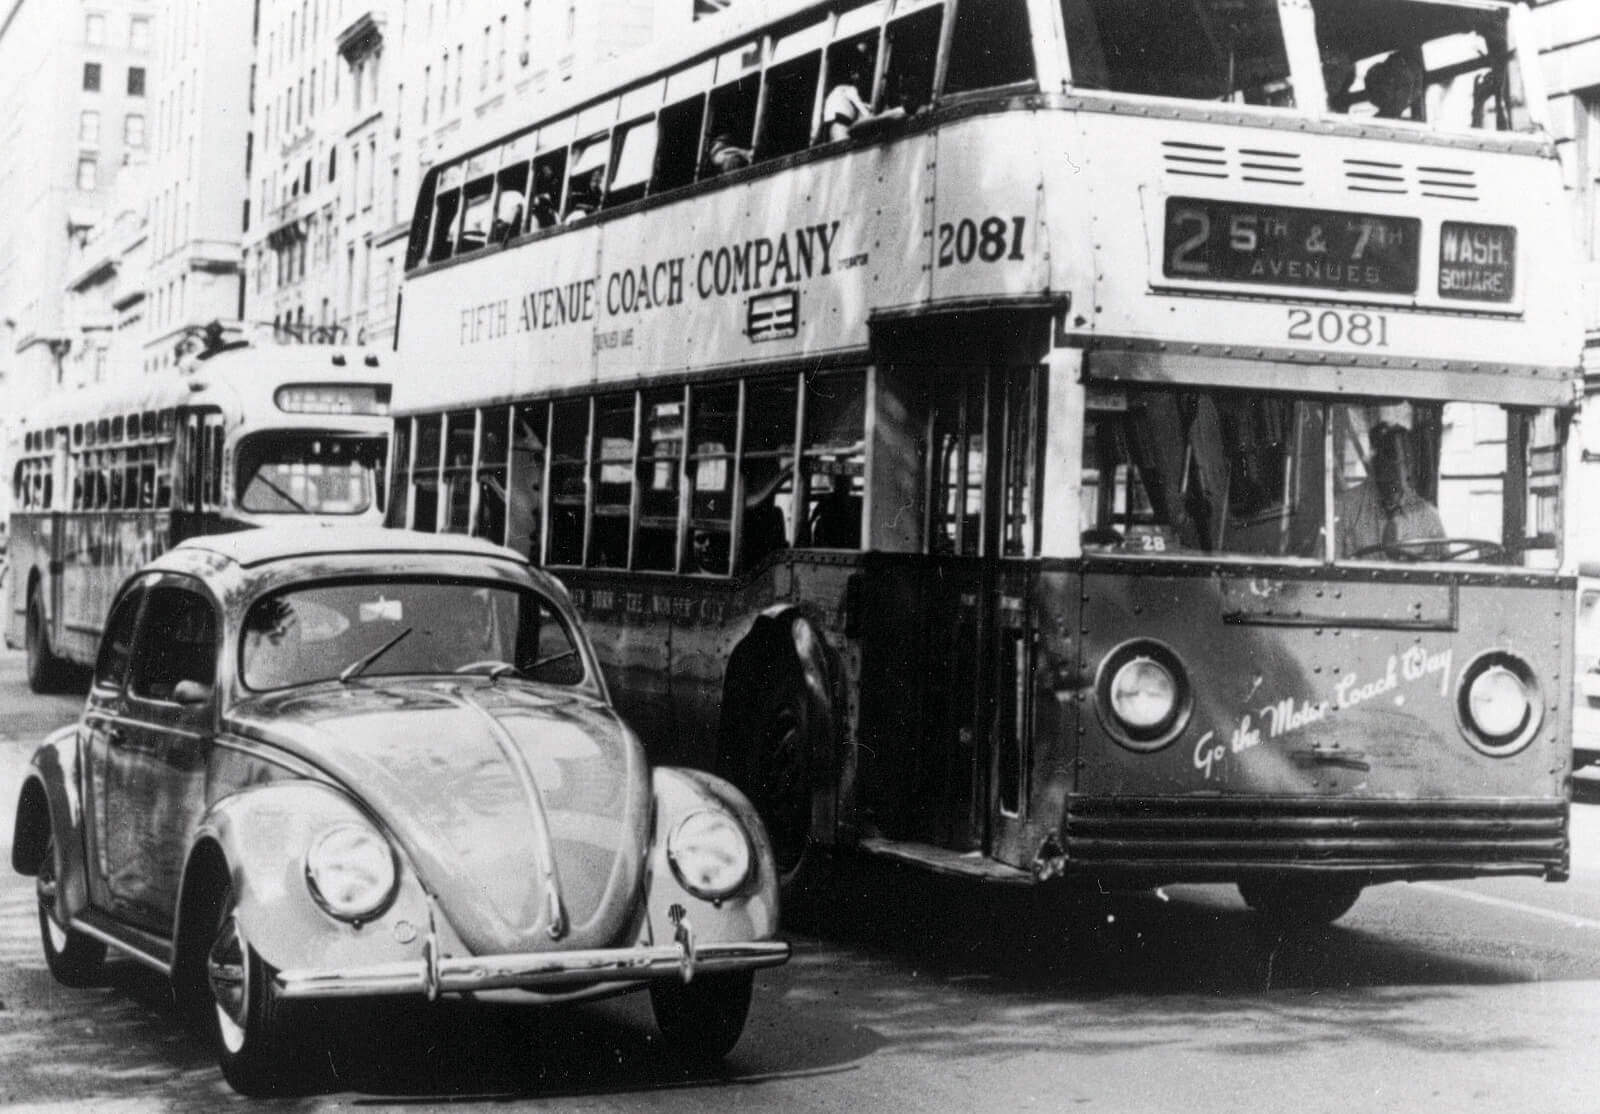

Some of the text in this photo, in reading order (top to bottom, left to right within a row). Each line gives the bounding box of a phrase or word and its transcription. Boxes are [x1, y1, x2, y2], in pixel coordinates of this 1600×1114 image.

[938, 216, 1025, 268] 2081
[1170, 208, 1211, 273] 2
[1305, 226, 1327, 254] &
[460, 221, 839, 345] FIFTH AVENUE COACH COMPANY
[1250, 259, 1380, 284] AVENUES
[1440, 268, 1505, 293] SQUARE
[1287, 309, 1388, 347] 2081
[1193, 731, 1226, 779] Go
[1232, 715, 1260, 753] the
[1260, 697, 1329, 738] Motor
[1335, 655, 1398, 709] Coach
